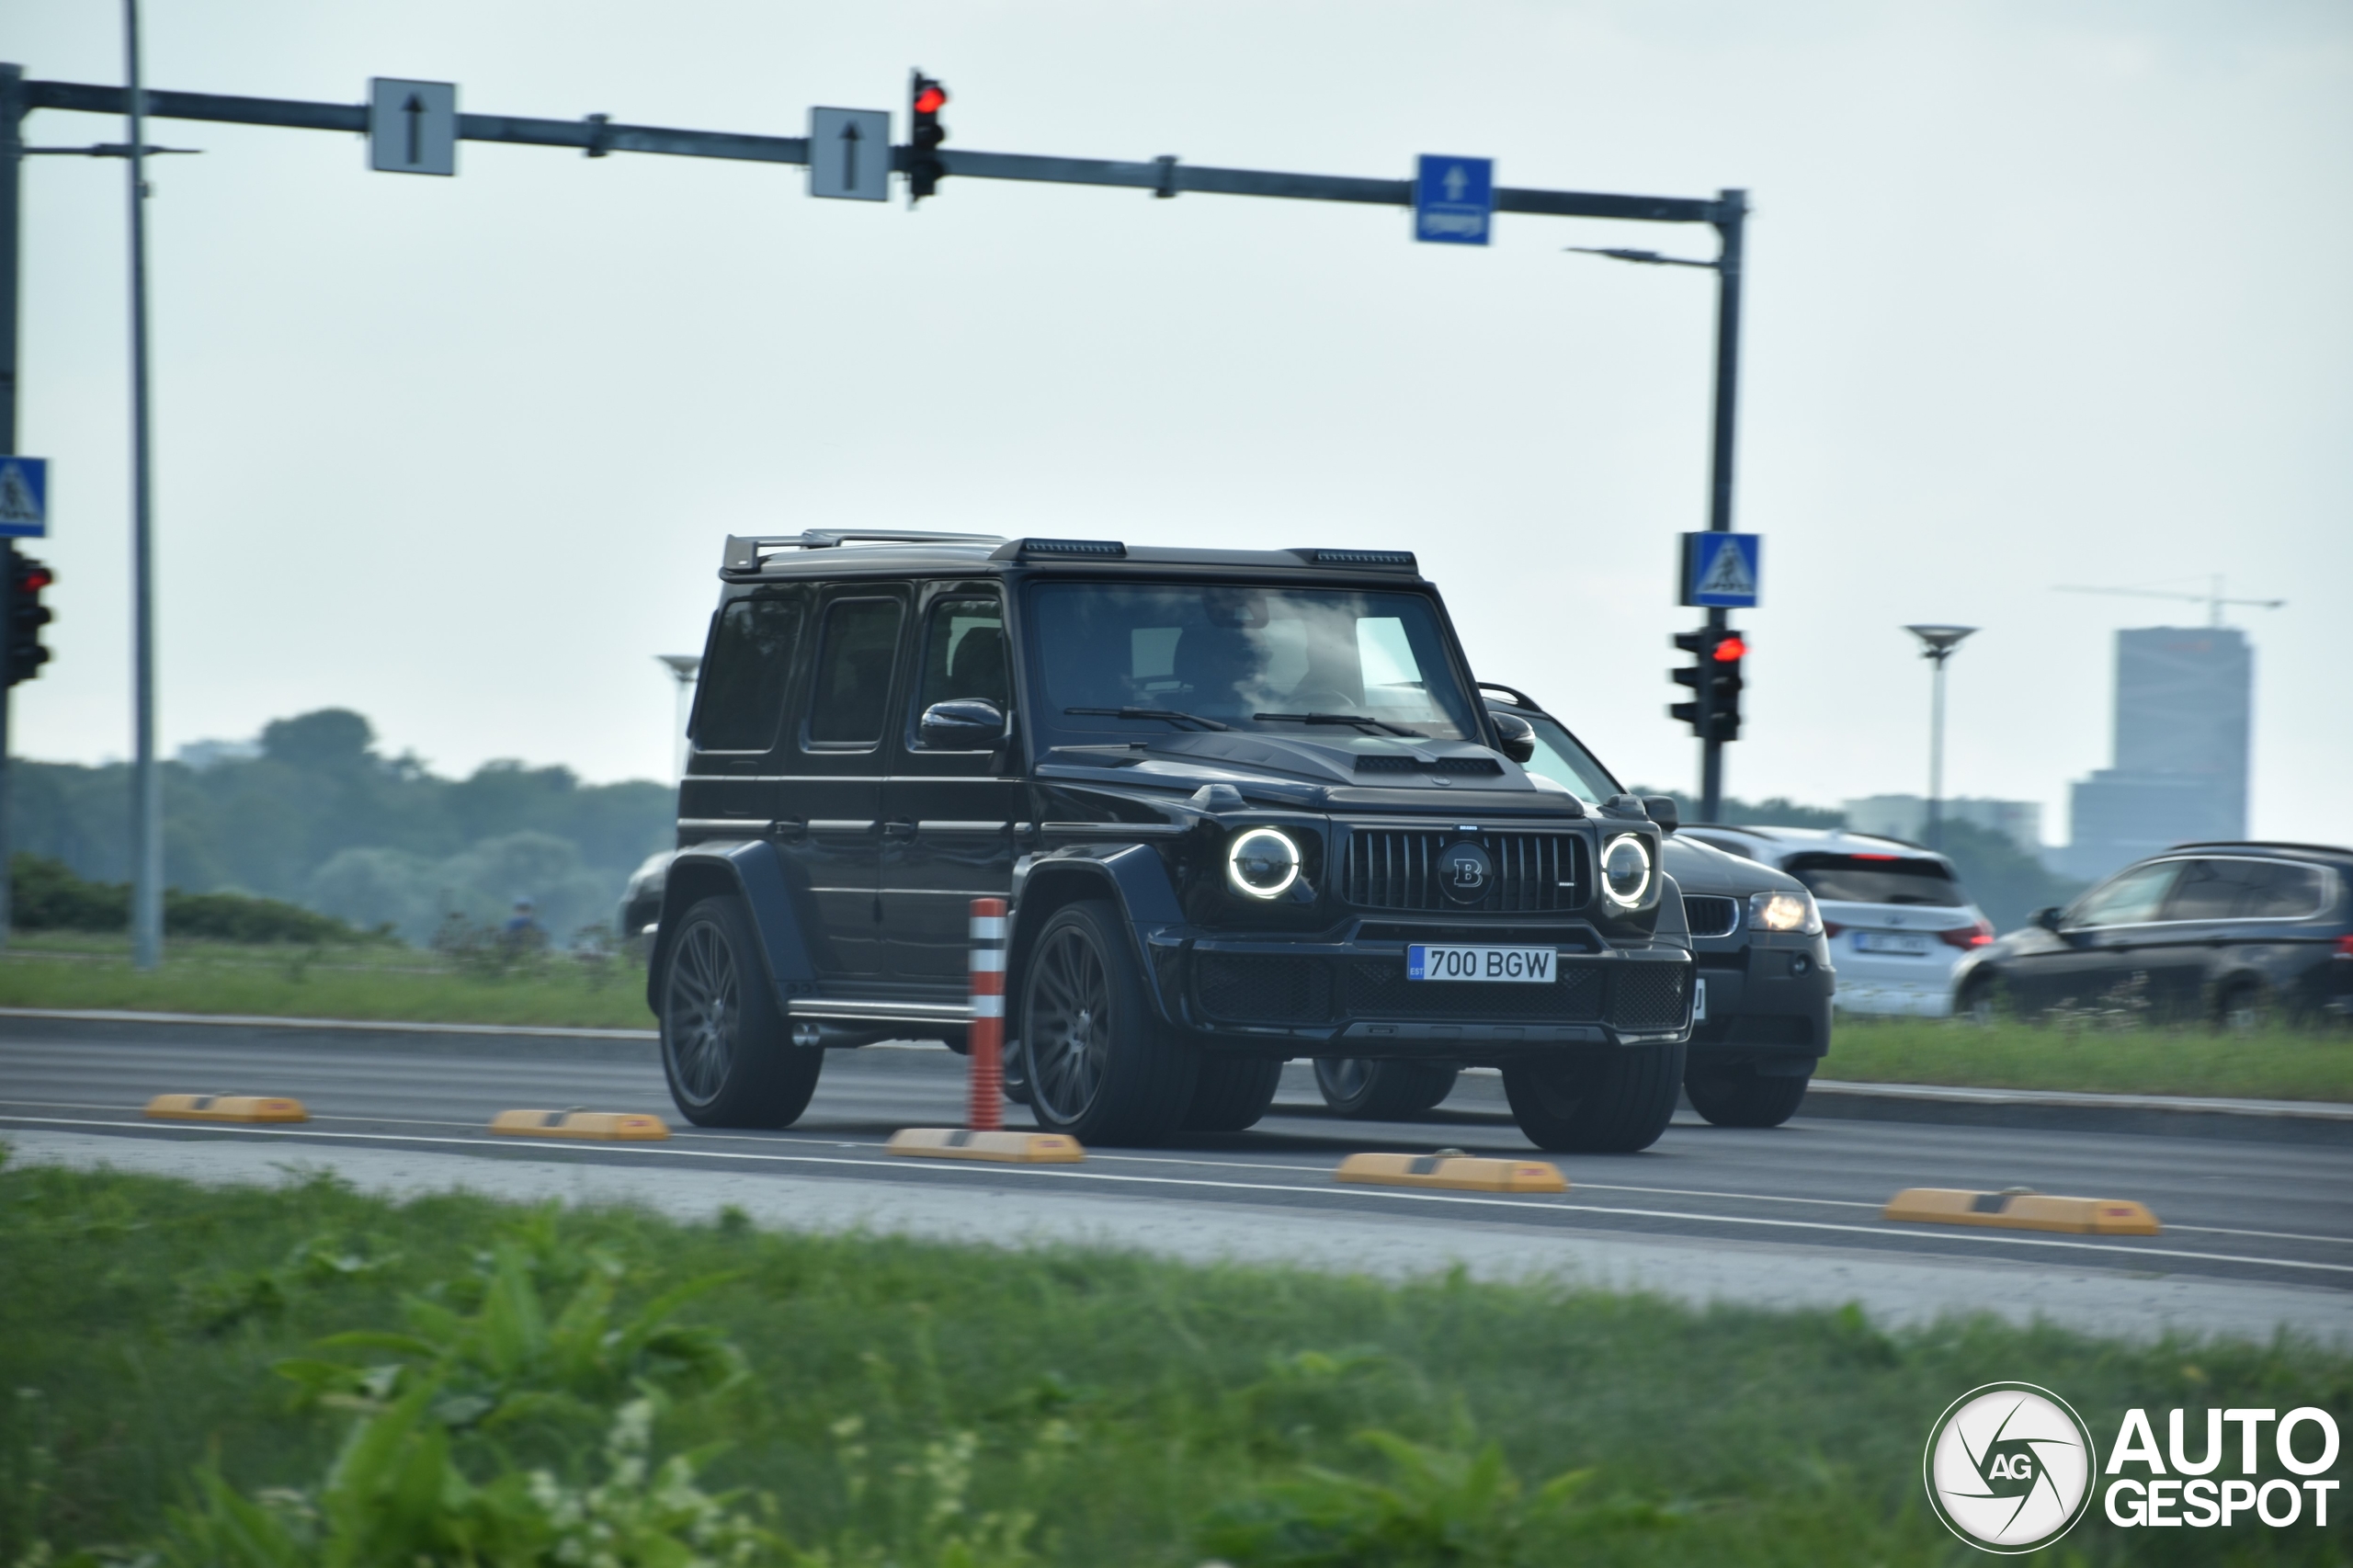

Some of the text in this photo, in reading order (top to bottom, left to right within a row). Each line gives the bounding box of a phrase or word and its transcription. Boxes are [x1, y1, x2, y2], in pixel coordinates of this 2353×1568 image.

[1453, 858, 1483, 888] B
[1410, 950, 1550, 978] EST 700 BGW
